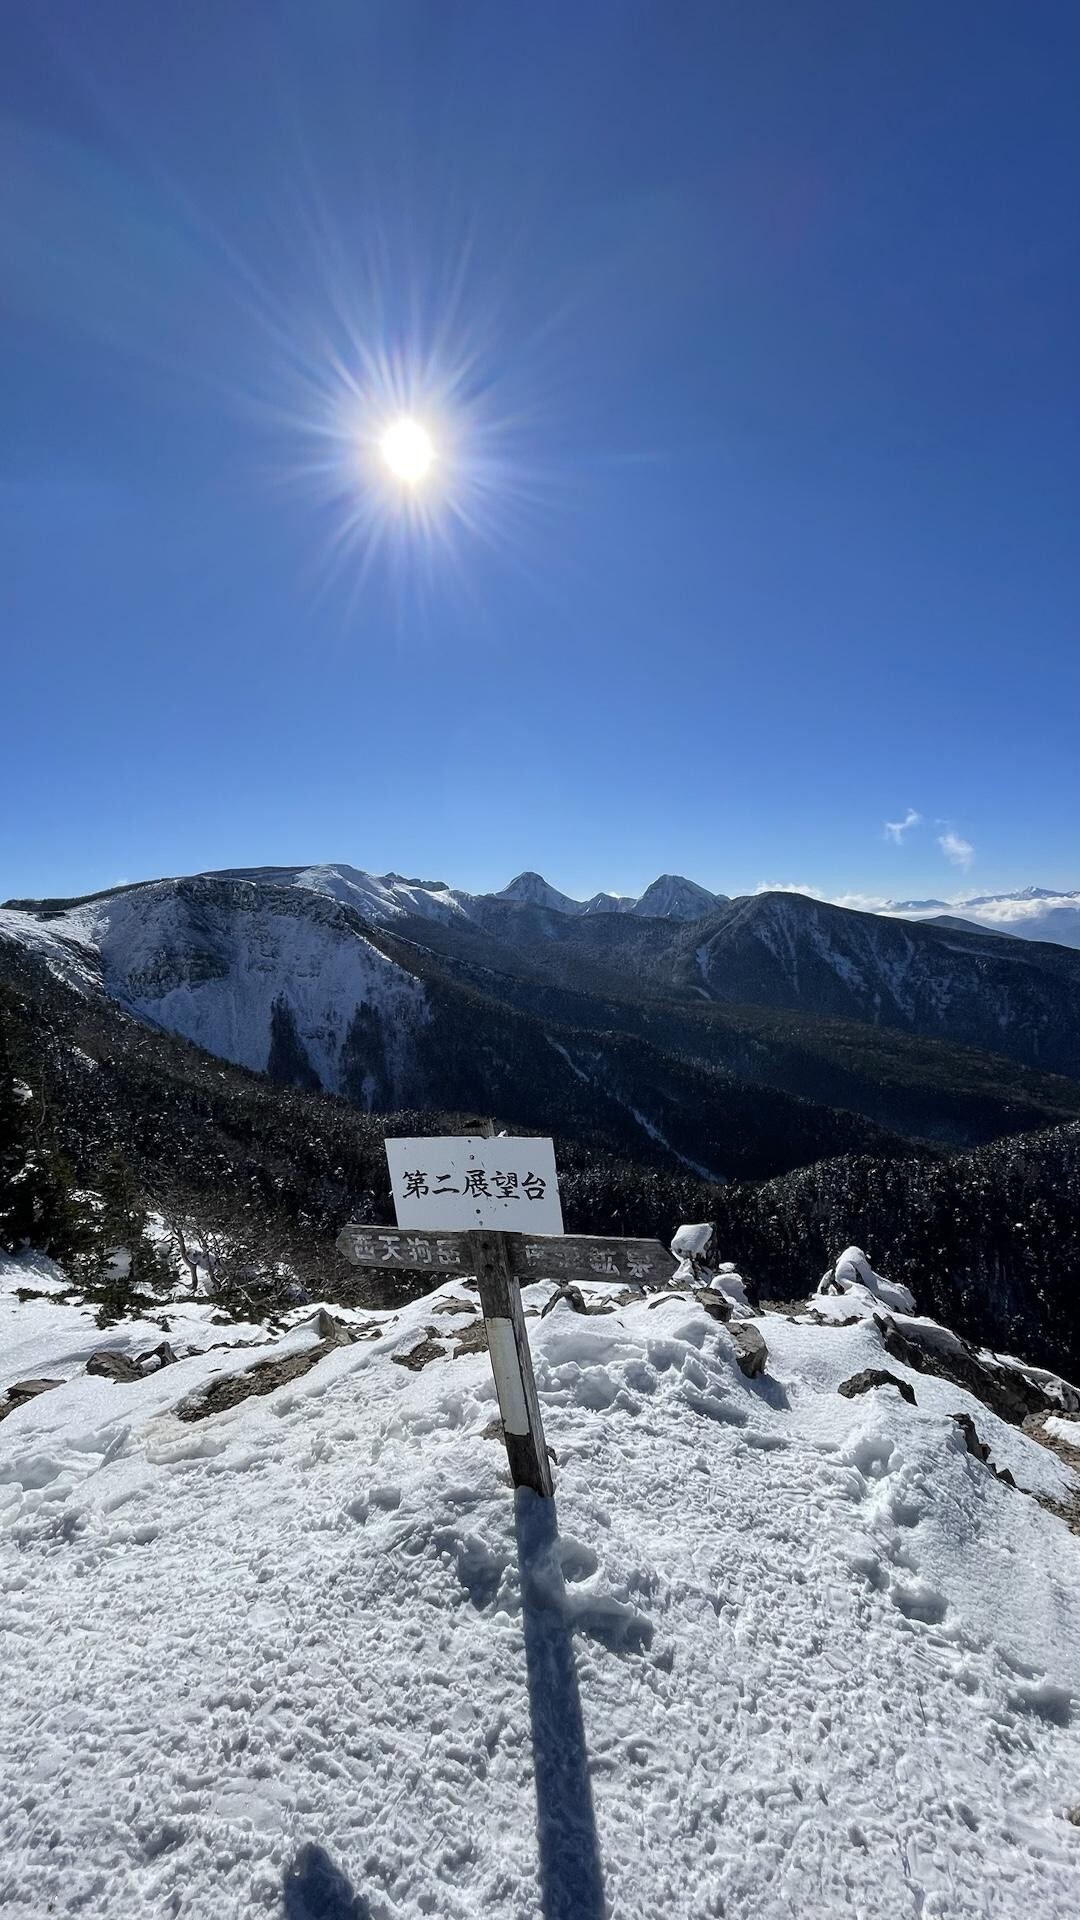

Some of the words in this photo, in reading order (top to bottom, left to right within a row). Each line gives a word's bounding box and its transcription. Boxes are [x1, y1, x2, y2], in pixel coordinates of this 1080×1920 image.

[402, 1169, 546, 1201] 第二展望台
[525, 1244, 653, 1278] 唐鉱泉
